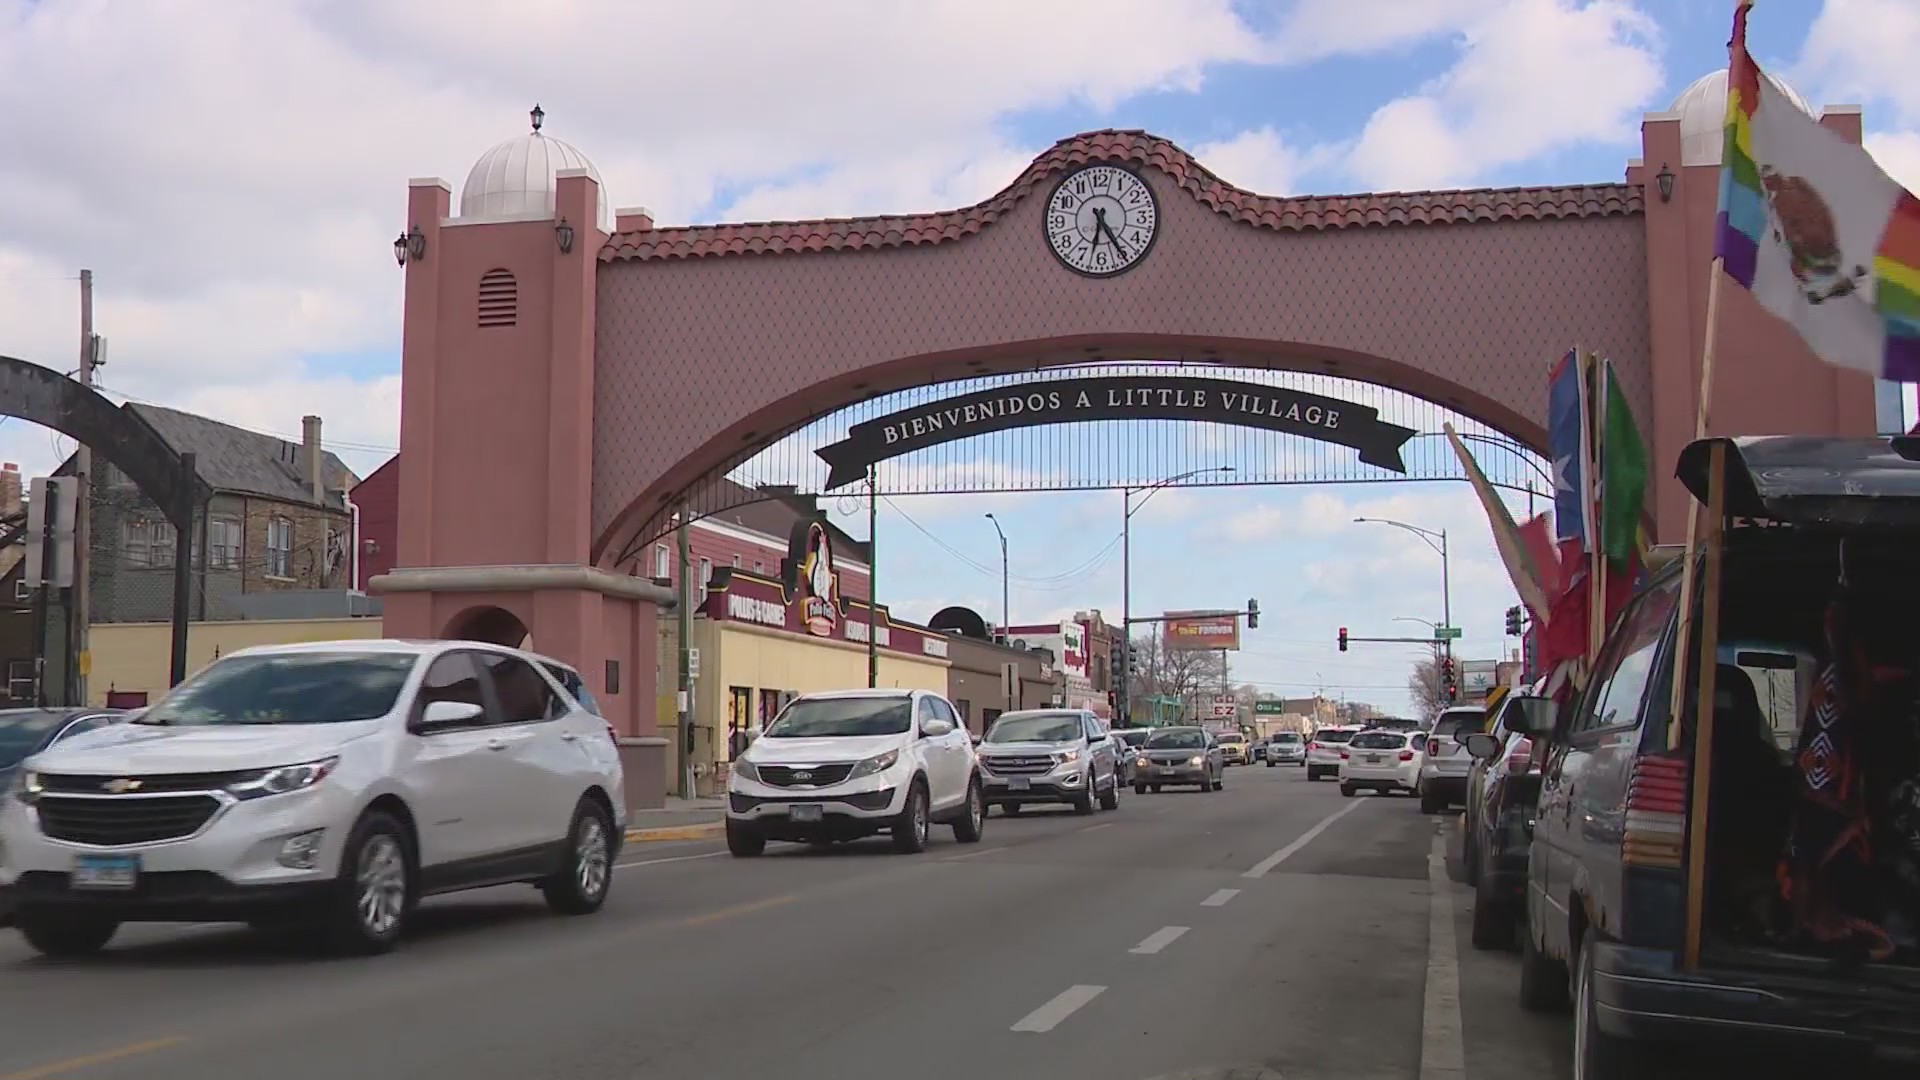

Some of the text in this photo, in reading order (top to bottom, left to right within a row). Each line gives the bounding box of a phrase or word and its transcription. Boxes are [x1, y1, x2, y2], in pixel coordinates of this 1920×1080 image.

[1076, 181, 1086, 194] 11
[1092, 174, 1108, 188] 12
[1117, 178, 1122, 191] 1
[1061, 196, 1074, 209] 10
[1130, 190, 1140, 204] 2
[1055, 215, 1065, 229] 9
[1137, 211, 1147, 224] 3
[1061, 235, 1072, 249] 8
[1130, 231, 1140, 244] 4
[1078, 247, 1088, 261] 7
[1096, 252, 1107, 266] 6
[883, 389, 1341, 444] BIENVENIDOS A LITTLE VILLAGE
[1214, 706, 1235, 715] EZ
